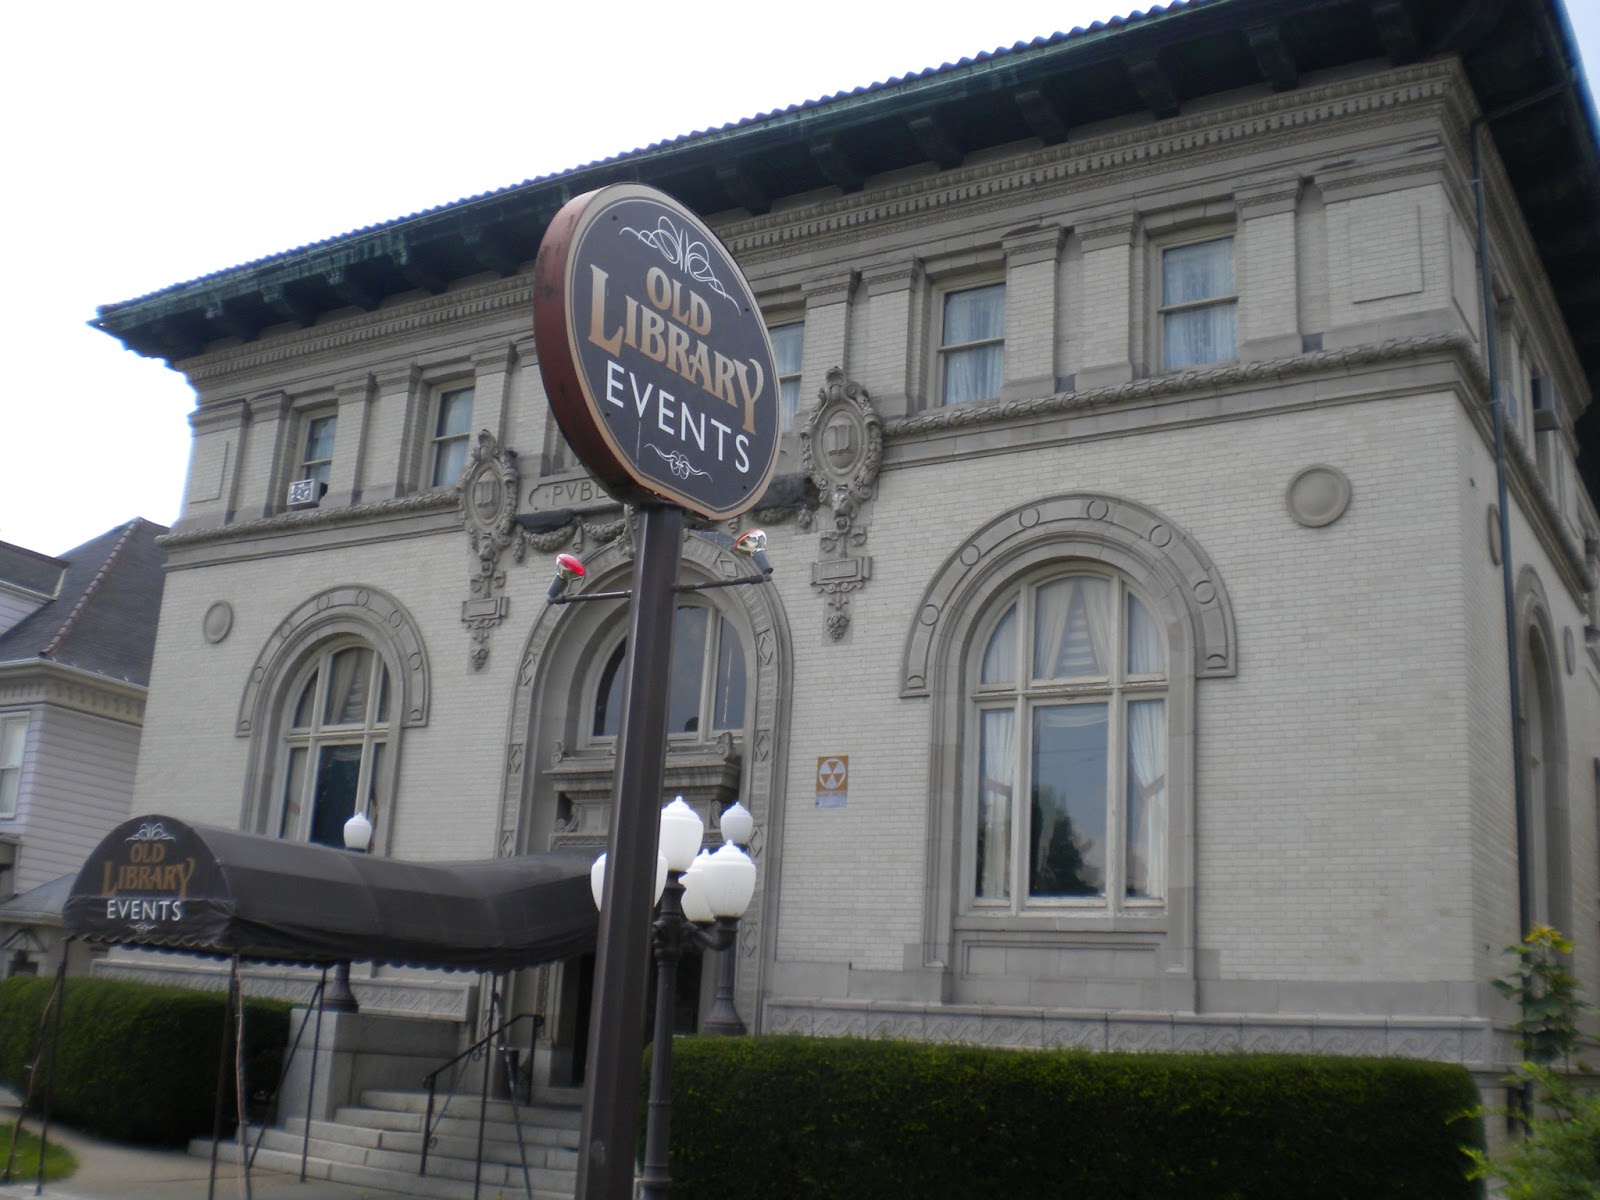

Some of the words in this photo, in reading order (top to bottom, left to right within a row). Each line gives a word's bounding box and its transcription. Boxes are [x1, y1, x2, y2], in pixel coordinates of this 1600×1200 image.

[646, 267, 712, 336] OLD
[588, 264, 764, 435] LIBRARY
[606, 359, 750, 473] EVENTS
[102, 857, 196, 899] LIBRARY
[129, 843, 165, 863] OLD
[106, 900, 182, 921] EVENTS
